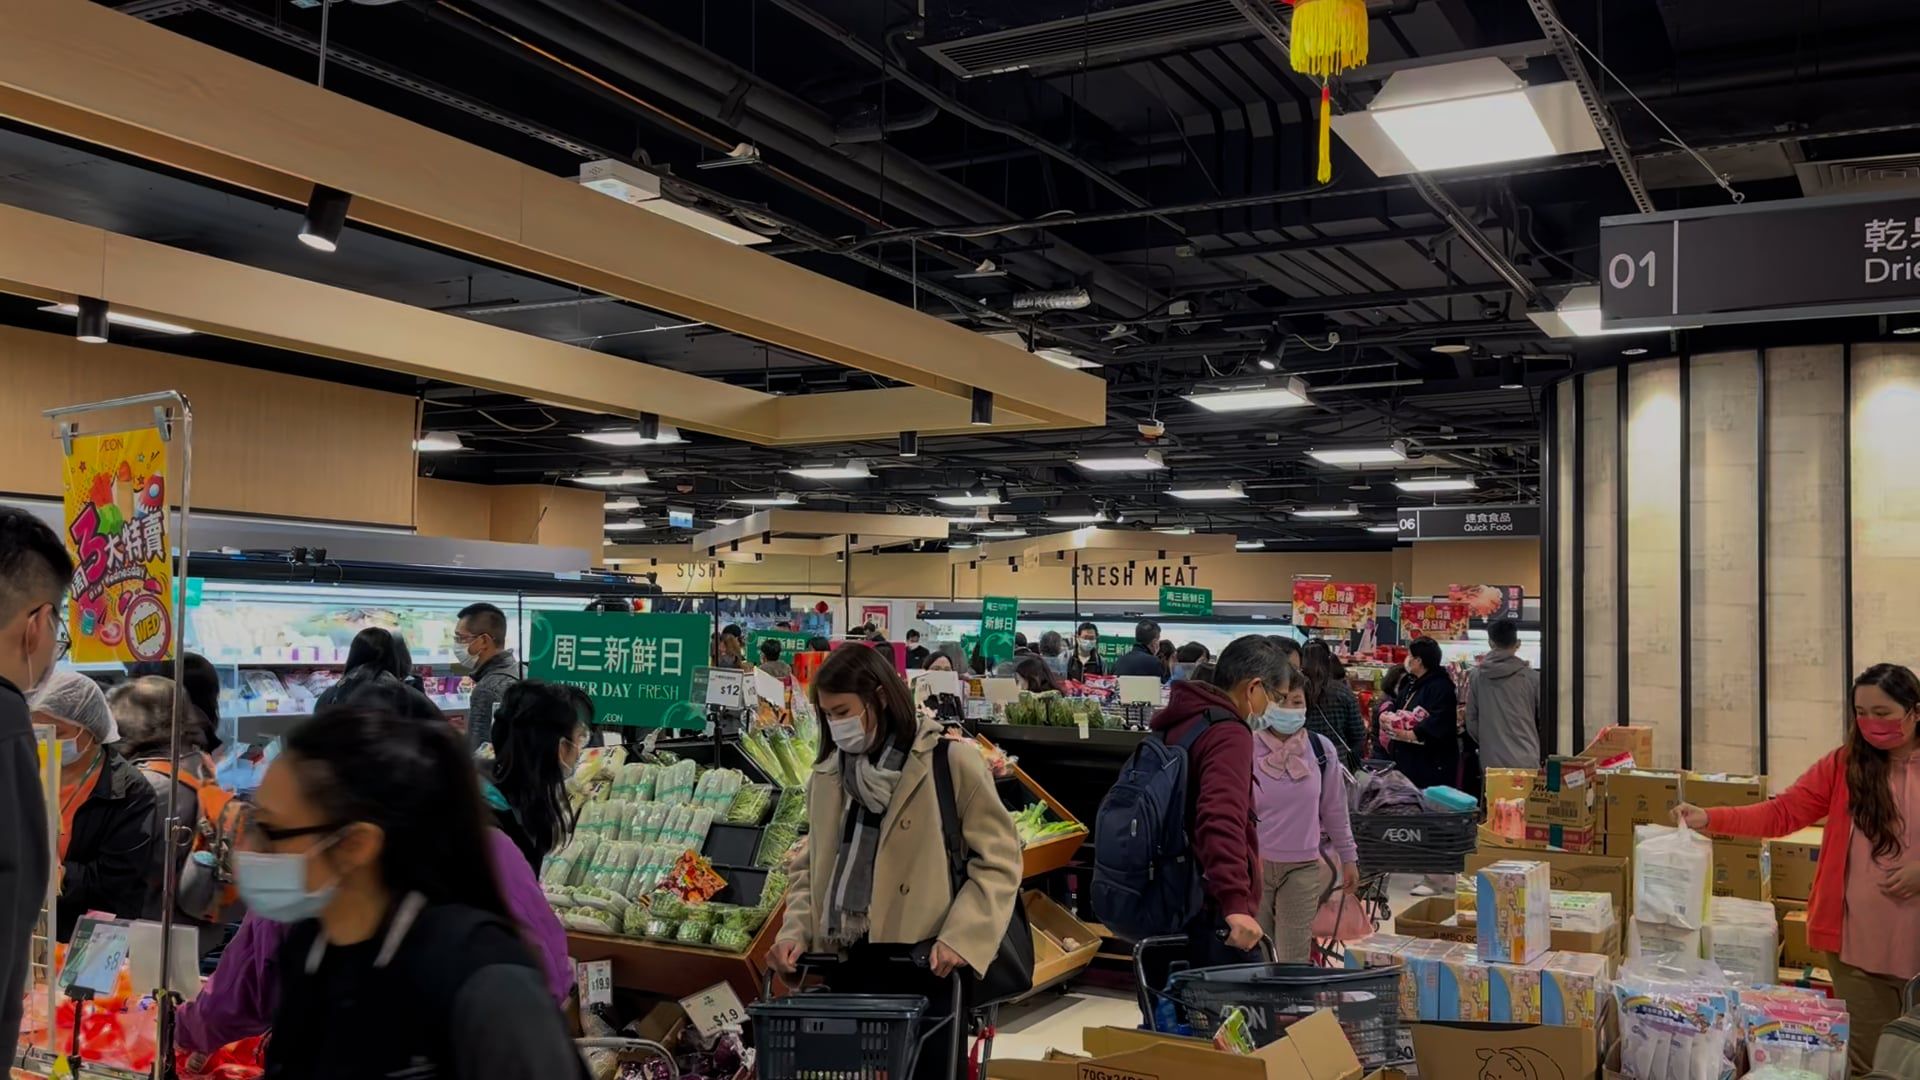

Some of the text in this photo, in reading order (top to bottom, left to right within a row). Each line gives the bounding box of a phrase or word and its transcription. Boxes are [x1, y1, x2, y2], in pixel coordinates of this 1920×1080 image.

[1608, 250, 1656, 289] 01
[1399, 518, 1416, 530] 06
[1464, 522, 1513, 532] Quick Food
[1072, 566, 1198, 586] FRESH MEAT
[134, 612, 161, 645] WED
[552, 634, 683, 676] 周三新鮮日
[602, 682, 632, 698] DAY
[638, 684, 679, 700] FRESH
[720, 684, 740, 696] $12
[712, 1008, 739, 1027] $1.9
